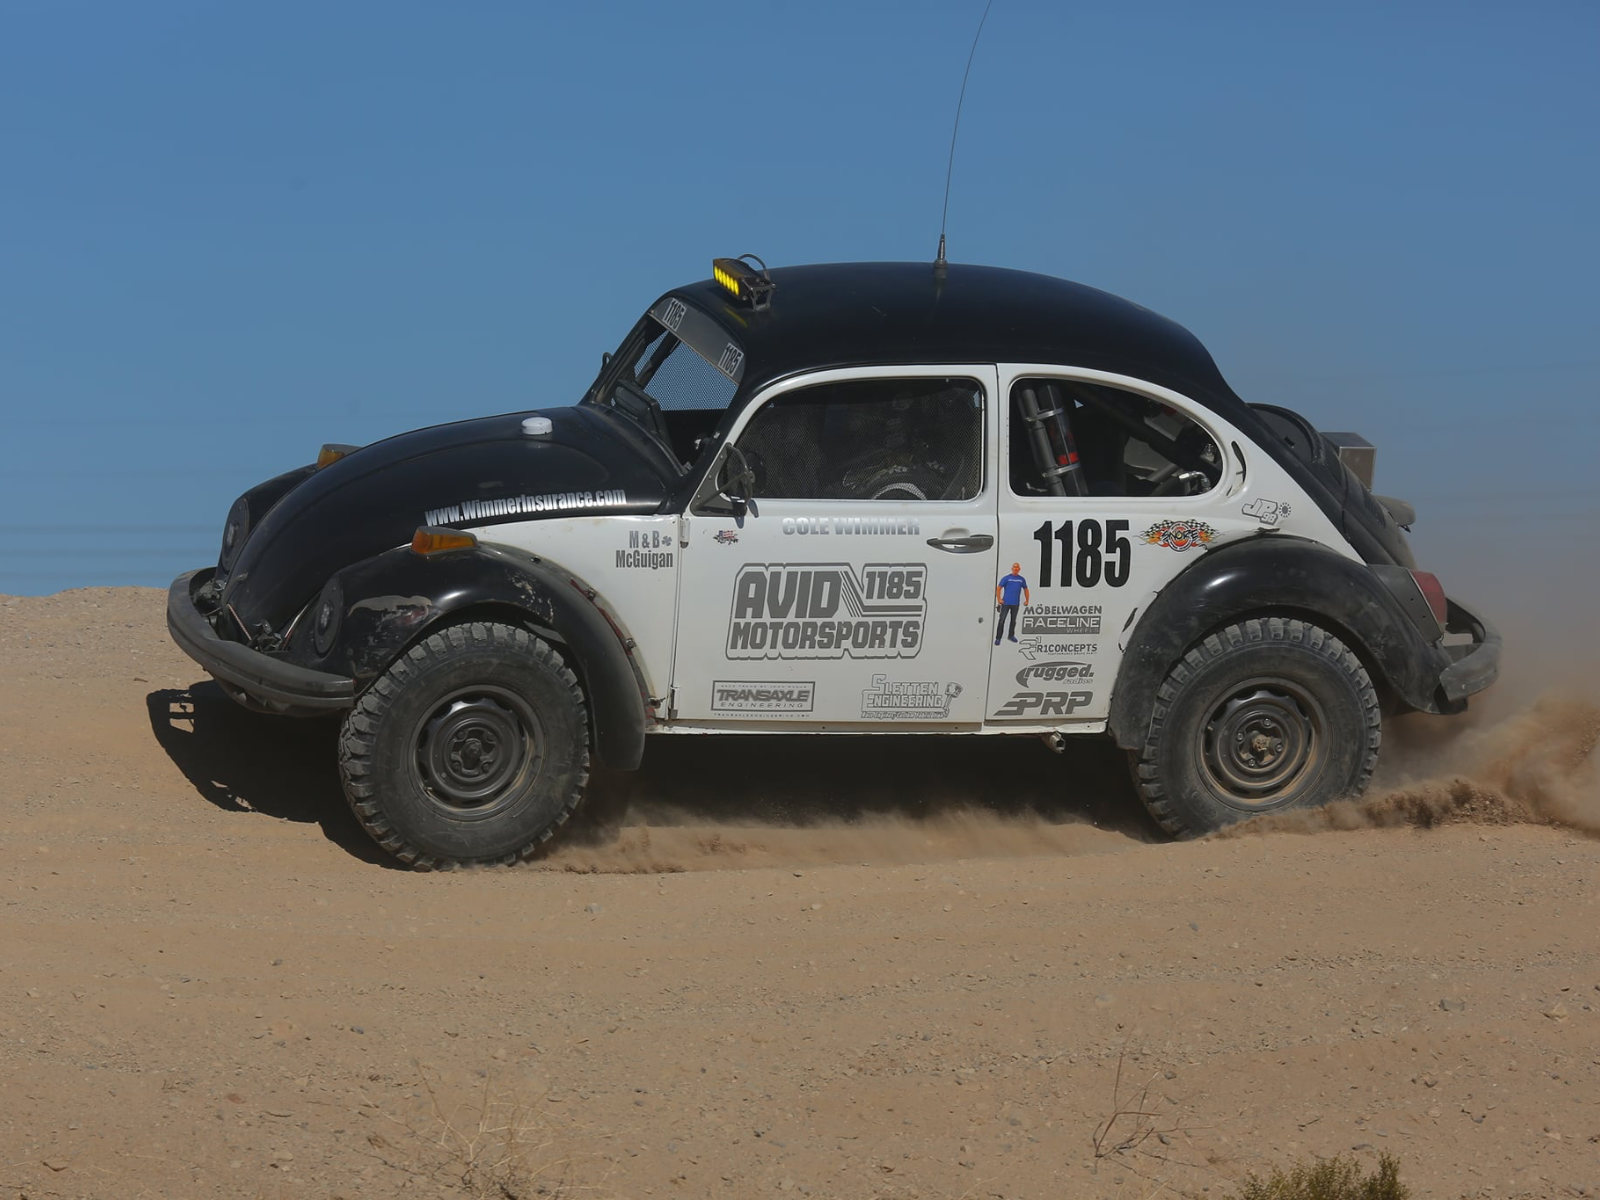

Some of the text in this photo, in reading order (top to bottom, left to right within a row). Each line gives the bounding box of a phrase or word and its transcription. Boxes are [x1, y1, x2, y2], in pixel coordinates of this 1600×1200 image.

[663, 299, 685, 330] 1185
[719, 344, 742, 375] 1185
[425, 488, 627, 527] www.WimmerInsurance.com
[782, 517, 920, 535] COLE WIMMER
[628, 531, 660, 549] M & B
[615, 550, 673, 569] McGuigan
[1033, 519, 1131, 588] 1185
[734, 571, 923, 619] AVID 1185
[1023, 604, 1102, 615] MÖBELWAGEN
[1023, 617, 1100, 628] RACELINE
[730, 621, 921, 650] MOTORSPORTS
[1037, 644, 1097, 653] R1CONCEPTS
[717, 689, 810, 702] TRANSAXLE
[862, 689, 943, 712] ENGINEERING
[993, 691, 1094, 716] PRP
